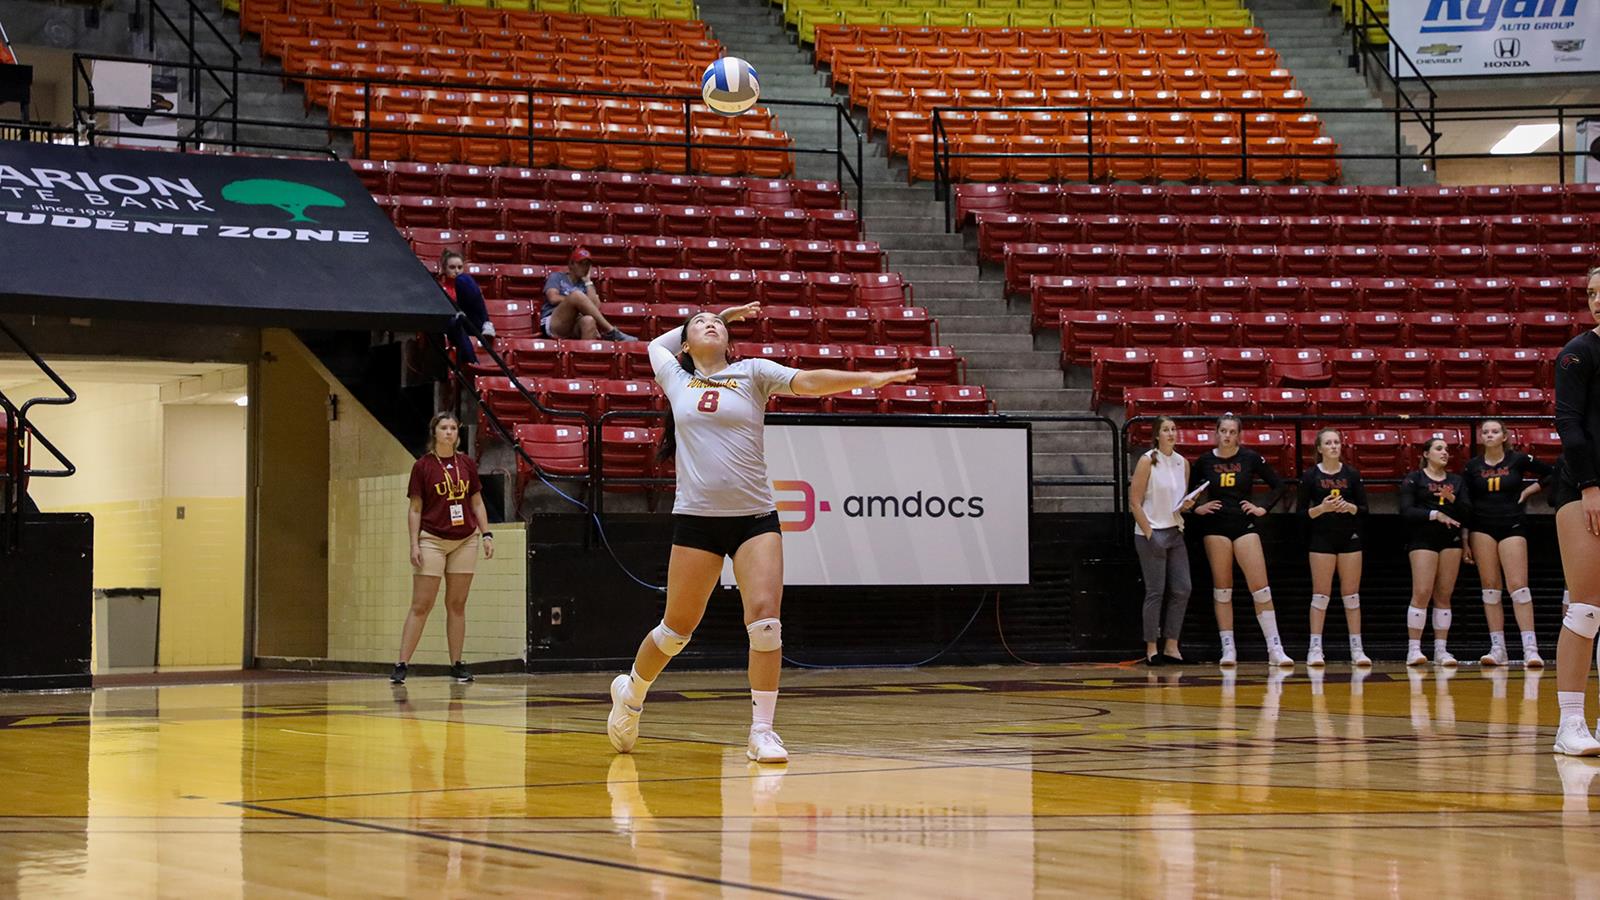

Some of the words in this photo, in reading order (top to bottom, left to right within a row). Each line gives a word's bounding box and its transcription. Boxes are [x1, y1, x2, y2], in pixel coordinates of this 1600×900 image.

[1498, 23, 1530, 31] AUTO
[1534, 22, 1575, 30] GROUP
[31, 203, 75, 214] since
[79, 208, 115, 217] 1907
[84, 193, 215, 212] BANK
[0, 211, 208, 236] UDENT
[218, 225, 370, 243] ZONE
[696, 389, 720, 413] 8
[1220, 473, 1236, 487] 16
[1487, 476, 1501, 492] 11
[843, 490, 985, 518] amdocs
